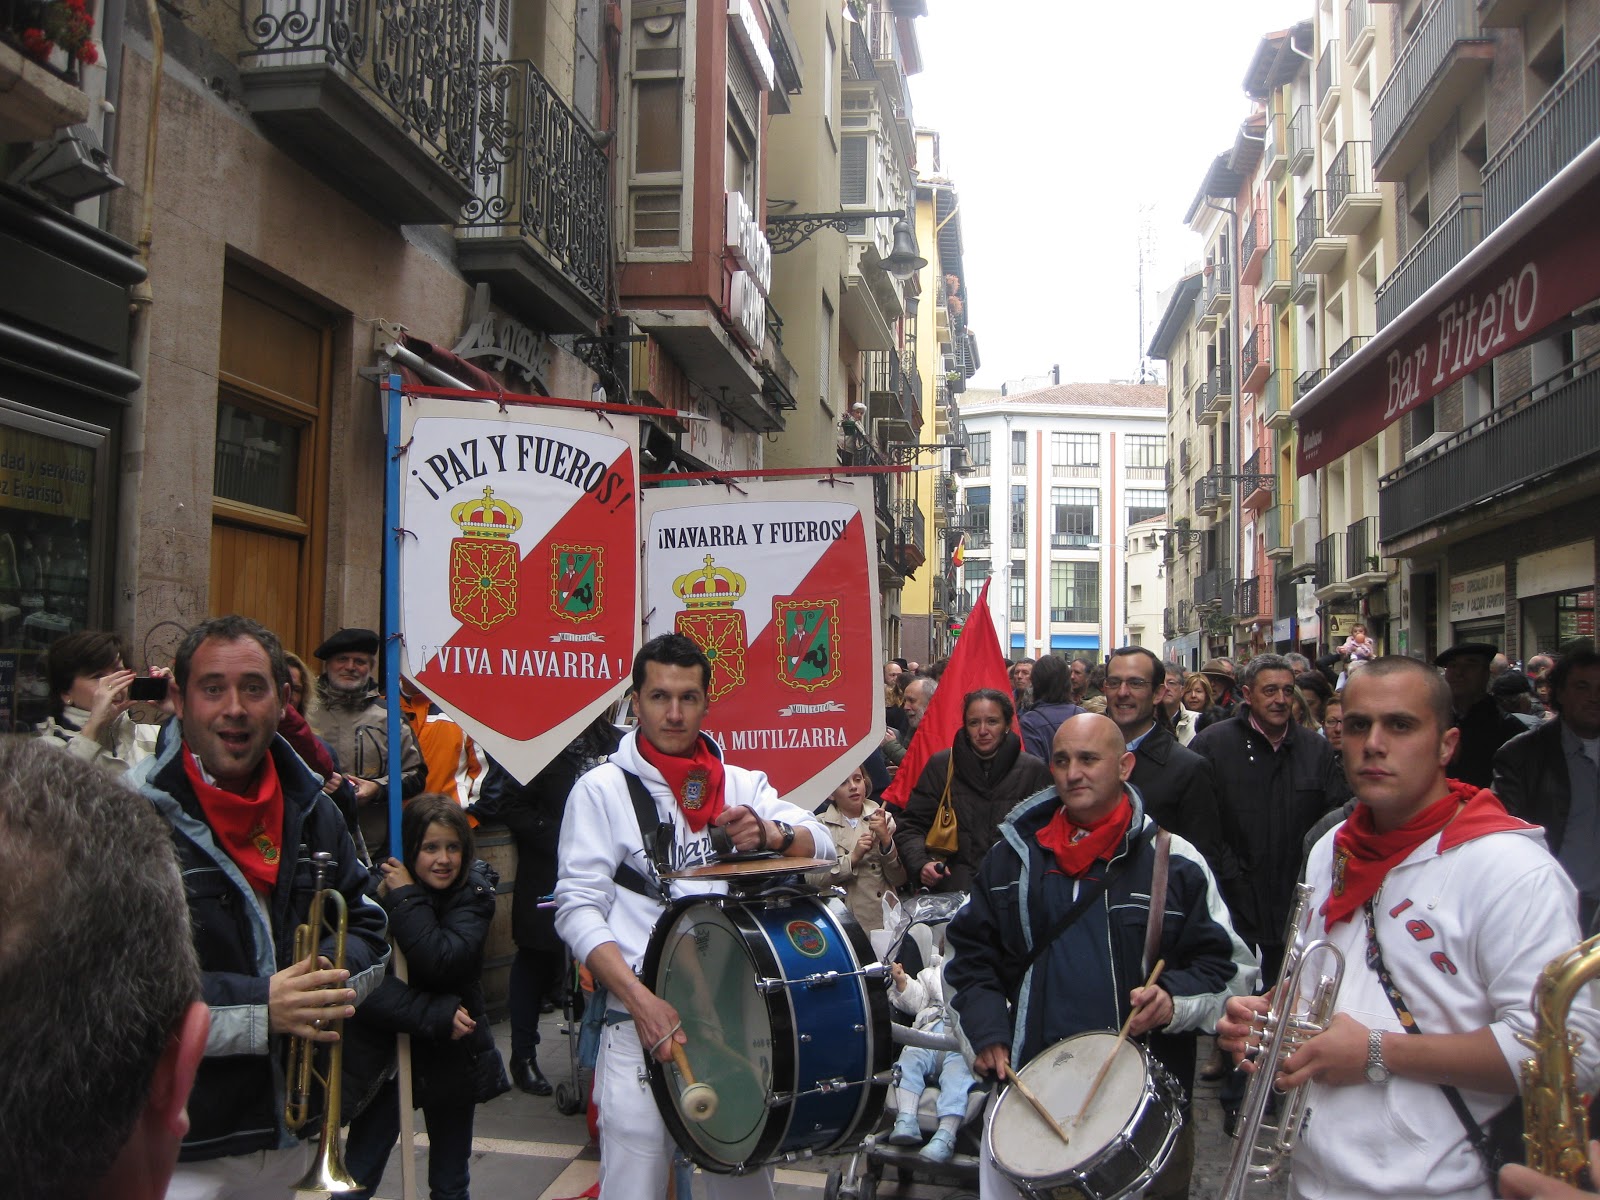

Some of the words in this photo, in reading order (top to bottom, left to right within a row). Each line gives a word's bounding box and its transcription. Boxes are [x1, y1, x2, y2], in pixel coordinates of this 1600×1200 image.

[1384, 343, 1427, 420] Bar
[1432, 262, 1538, 386] Fitero
[487, 434, 507, 472] Y
[515, 434, 632, 514] FUEROS!
[752, 523, 765, 545] Y
[732, 727, 849, 751] MUTILZARRA
